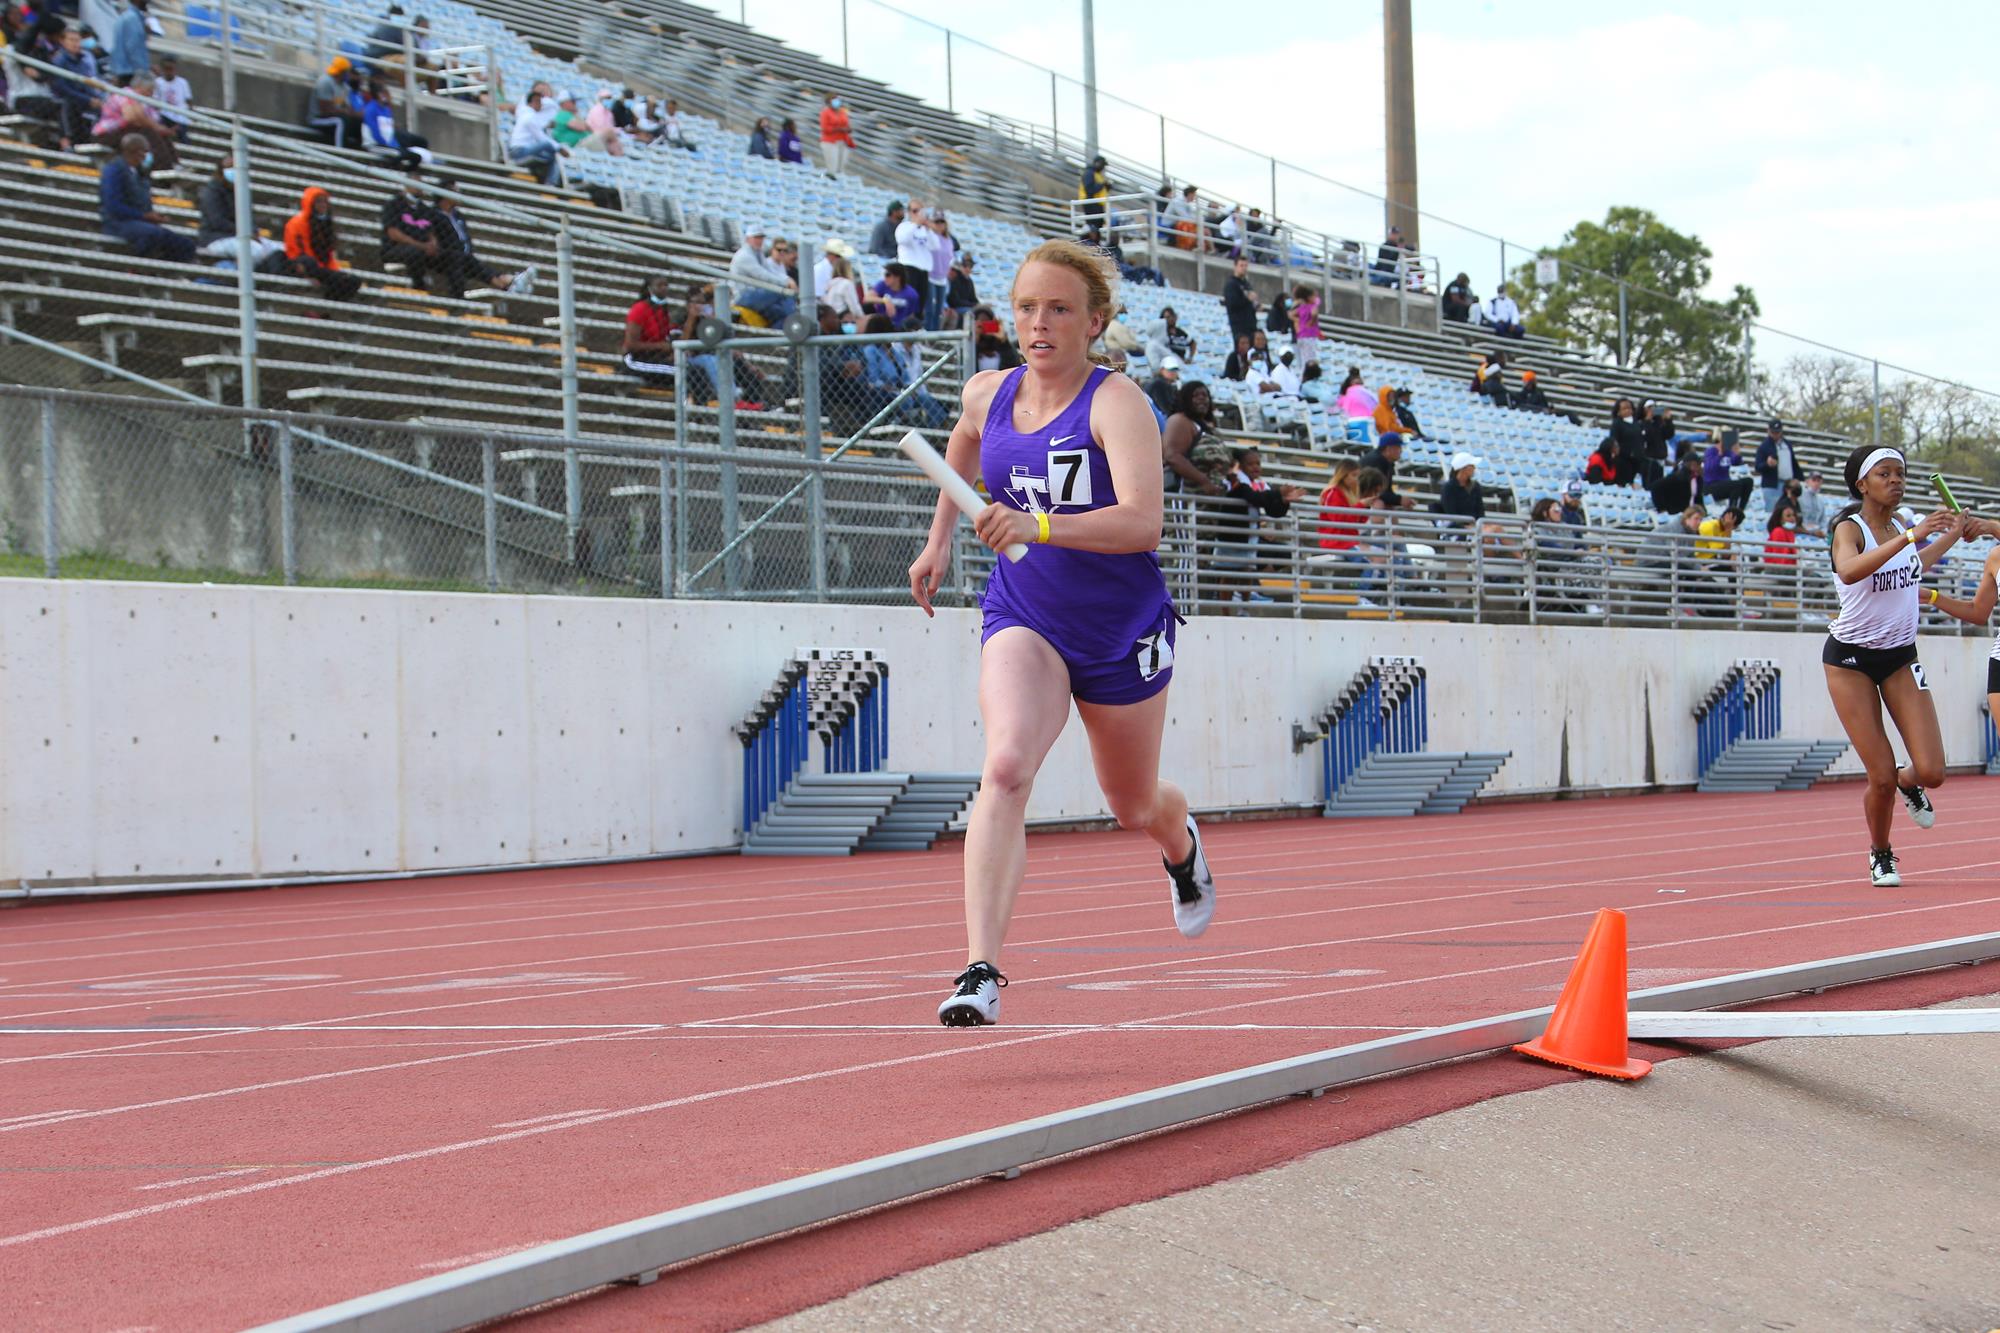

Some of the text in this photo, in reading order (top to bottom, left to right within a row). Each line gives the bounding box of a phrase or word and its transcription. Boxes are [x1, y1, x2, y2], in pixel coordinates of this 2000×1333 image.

[1053, 454, 1083, 502] 7
[1910, 555, 1920, 579] 2
[1872, 569, 1898, 593] FORT
[831, 650, 854, 660] UCS
[820, 661, 842, 670] UCS
[815, 671, 837, 681] UCS
[1915, 665, 1928, 688] 2
[809, 682, 832, 691] UCS
